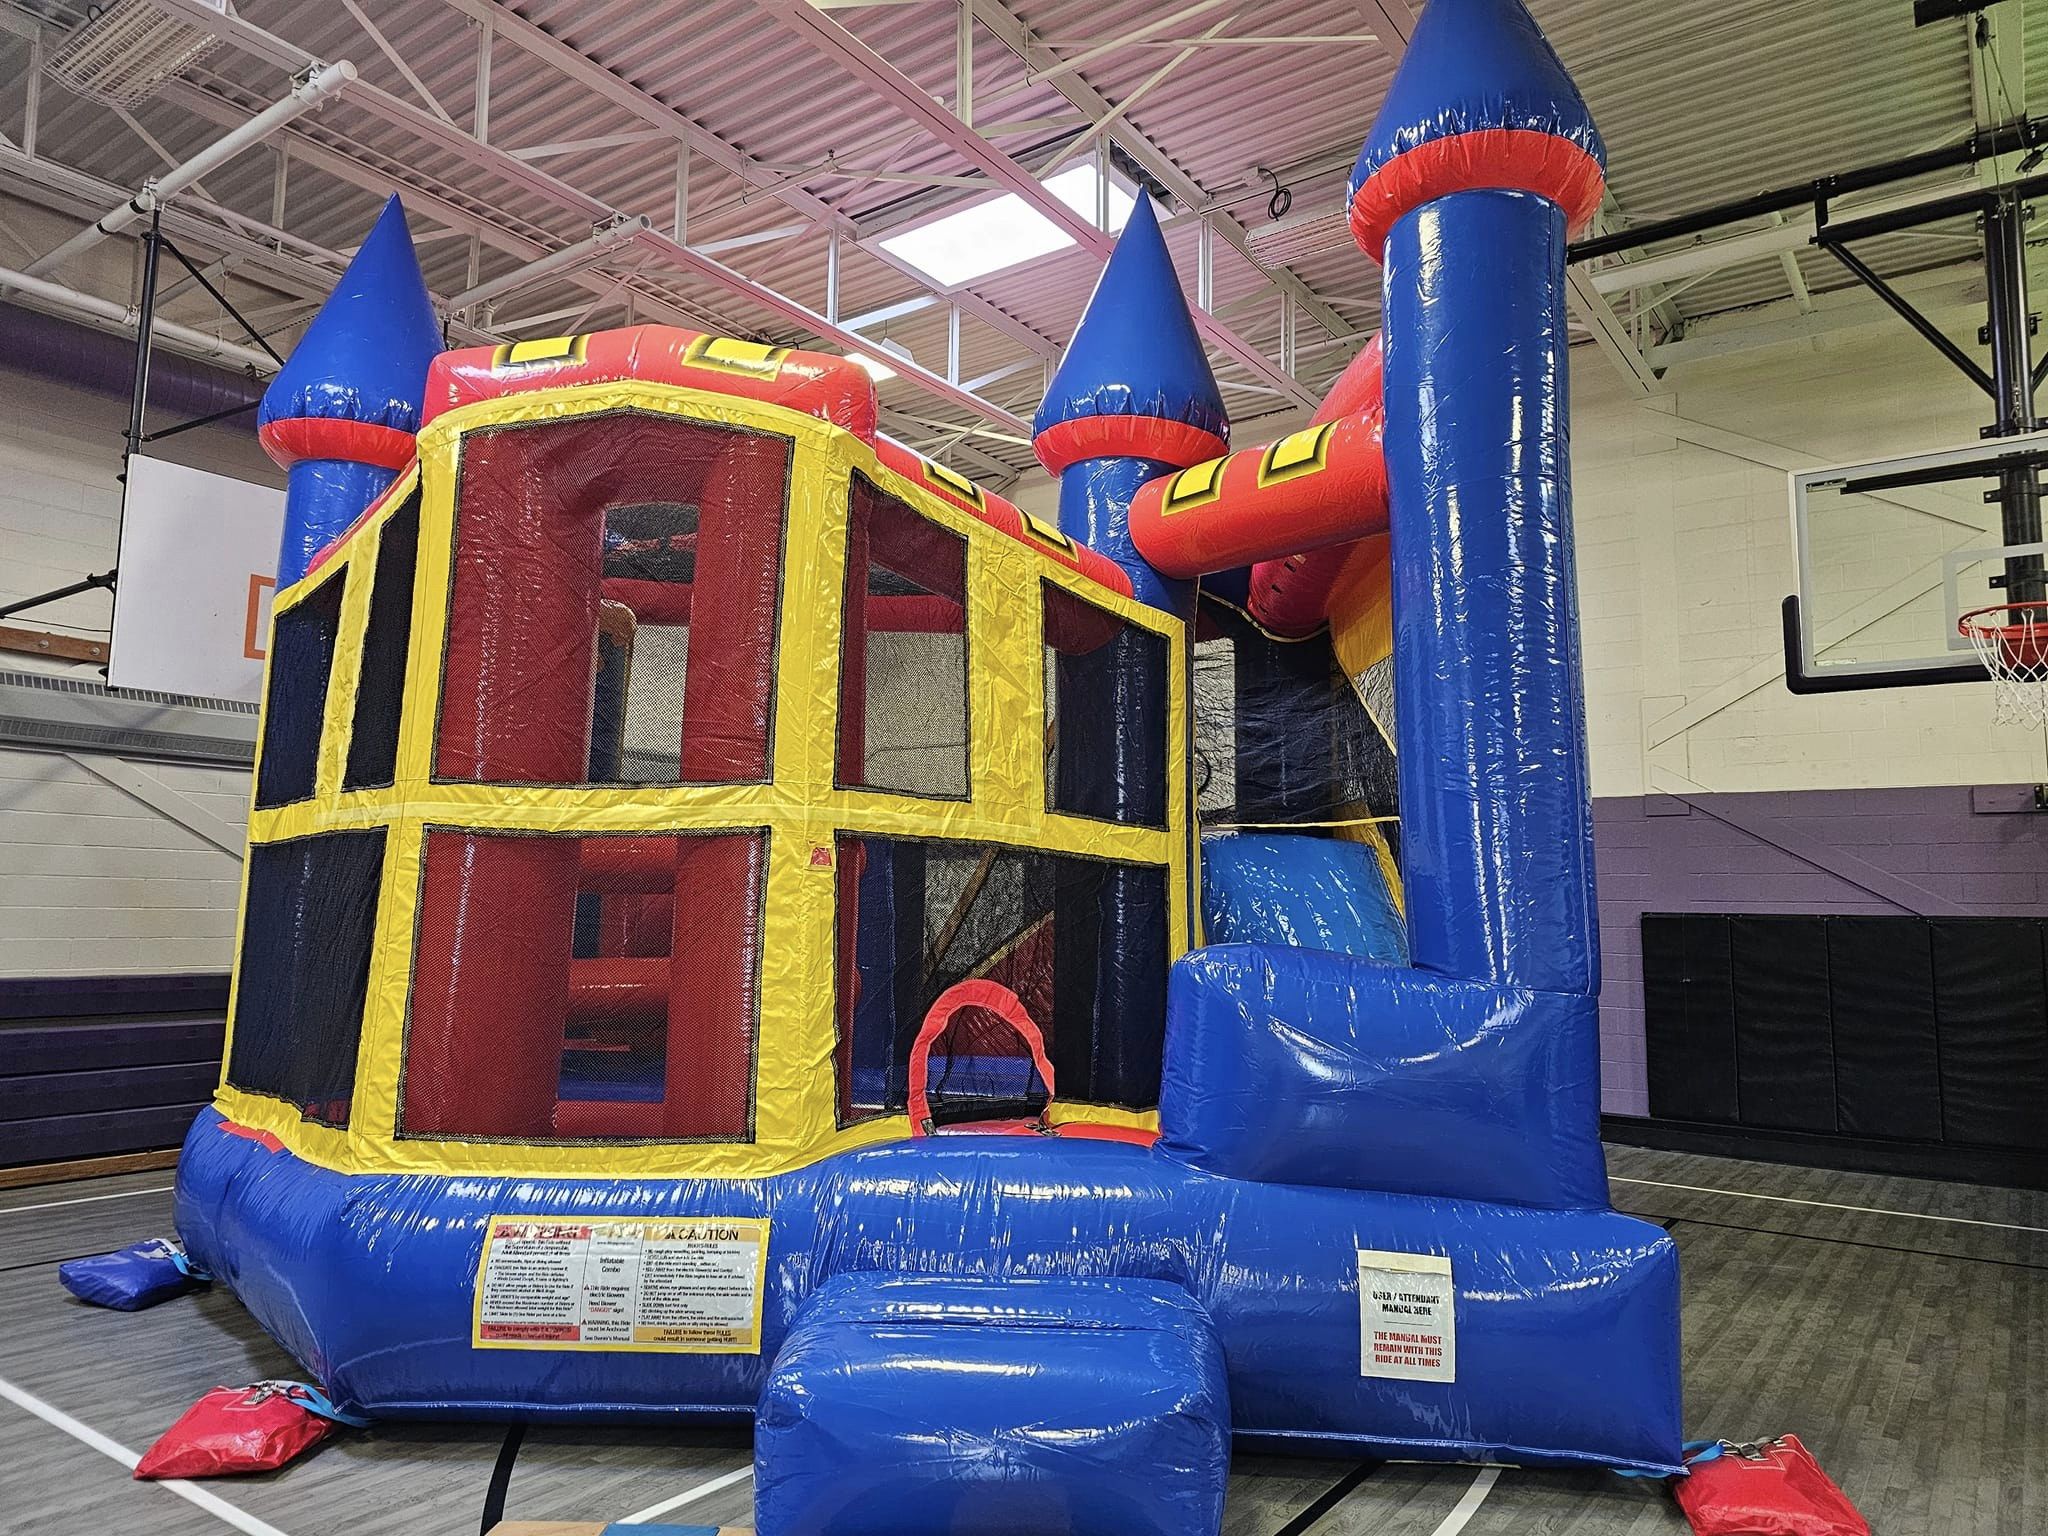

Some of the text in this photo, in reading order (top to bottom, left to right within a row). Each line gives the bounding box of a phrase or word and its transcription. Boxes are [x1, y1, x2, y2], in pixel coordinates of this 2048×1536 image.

[678, 1228, 739, 1240] CAUTION
[1398, 1293, 1440, 1305] ATTENDANT
[1382, 1303, 1413, 1314] MANUAL
[1374, 1331, 1442, 1345] THE MANUAL MUST
[1374, 1343, 1442, 1356] REMAIN WITH THIS
[1376, 1355, 1441, 1367] RIDE AT ALL TIMES
